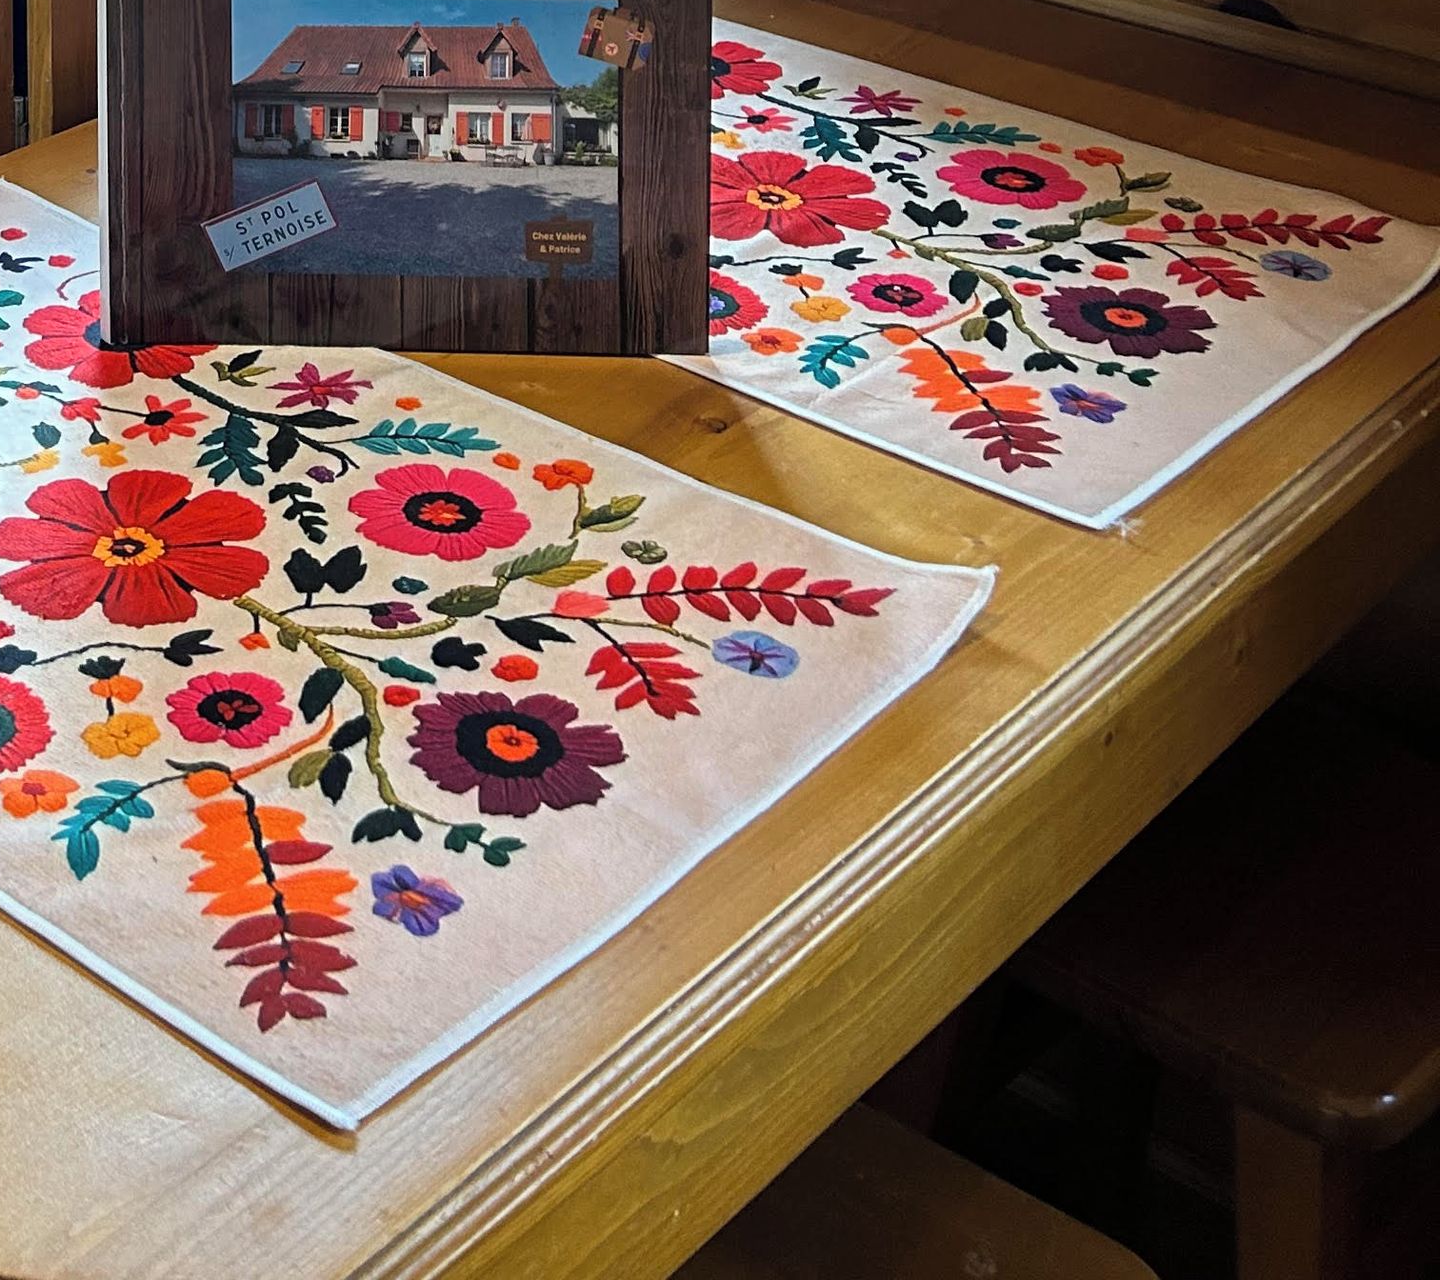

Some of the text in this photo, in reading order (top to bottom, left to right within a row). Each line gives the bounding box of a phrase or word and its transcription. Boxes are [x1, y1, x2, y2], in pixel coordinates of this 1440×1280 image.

[260, 201, 299, 225] POL
[241, 210, 327, 254] TERNOISE
[532, 231, 554, 240] Chez
[549, 244, 581, 254] Patrice
